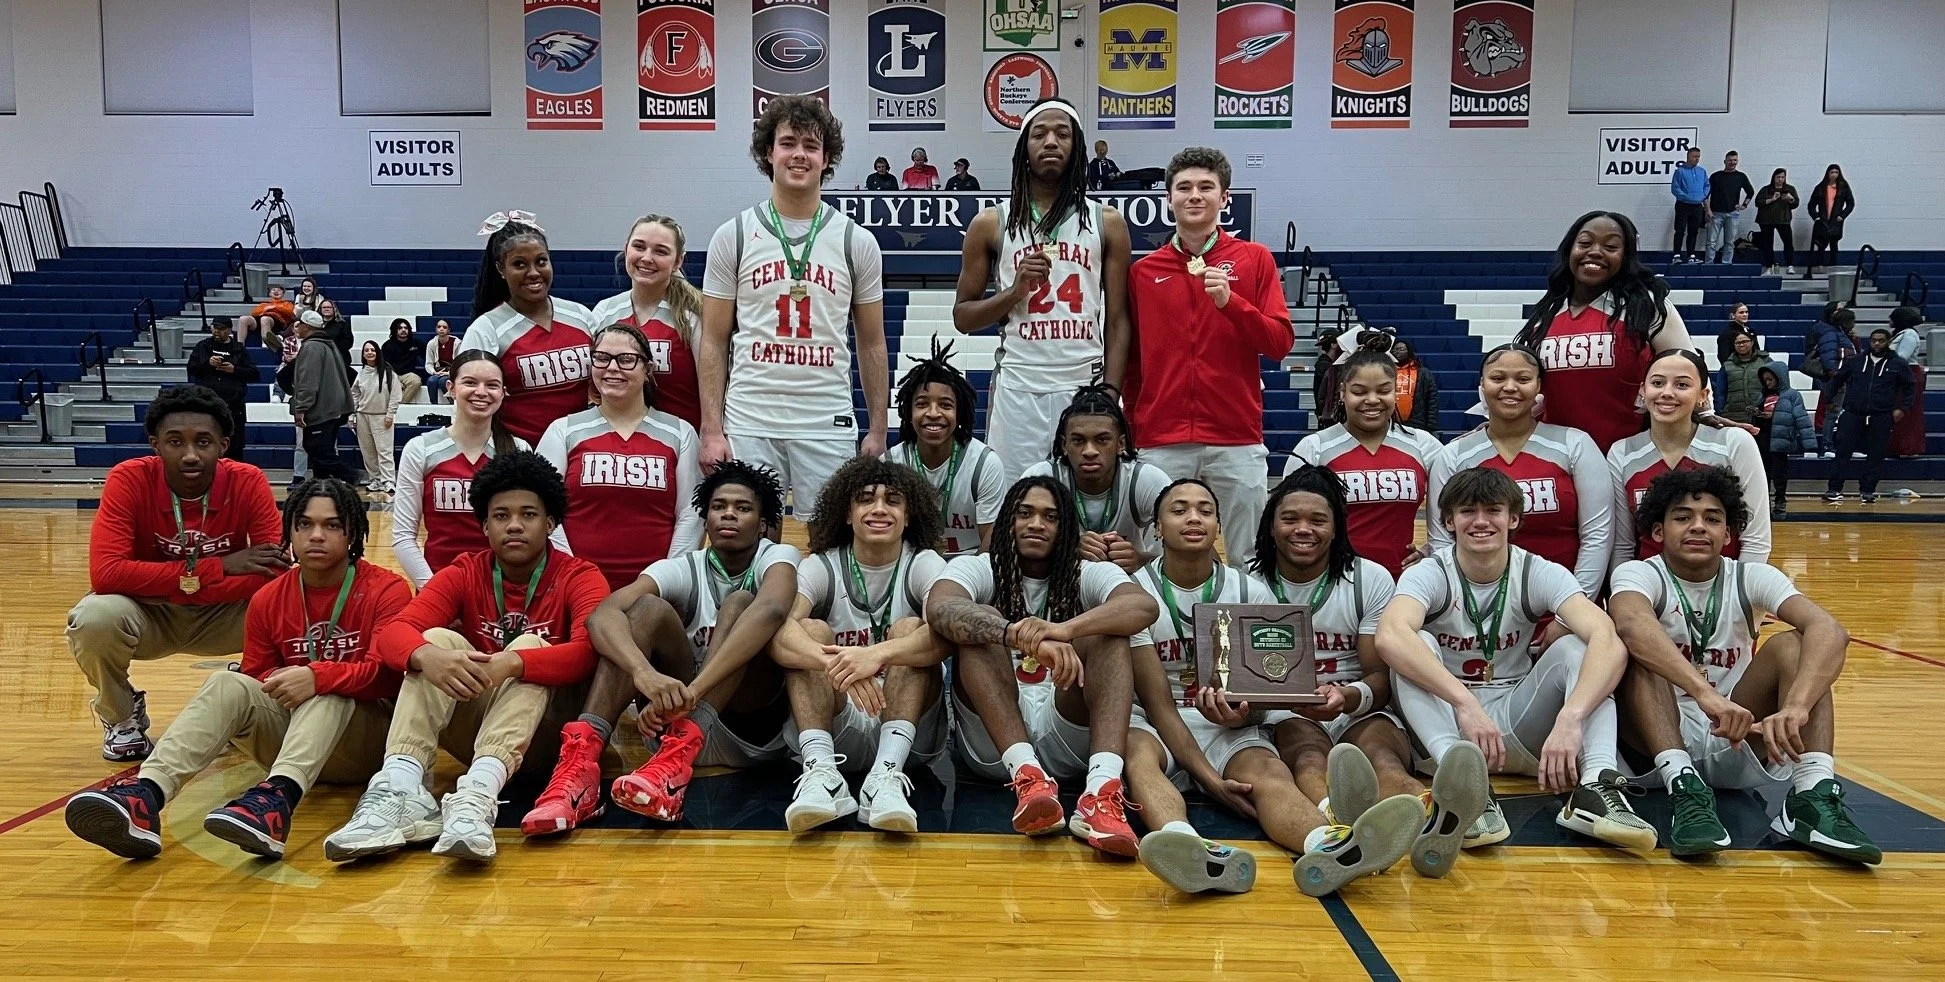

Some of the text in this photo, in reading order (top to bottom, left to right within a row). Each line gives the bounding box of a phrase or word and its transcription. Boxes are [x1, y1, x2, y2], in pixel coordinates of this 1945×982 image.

[990, 11, 1054, 32] OHSAA
[665, 30, 688, 66] F
[536, 98, 593, 116] EAGLES
[646, 97, 708, 116] REDMEN
[876, 97, 938, 118] FLYERS
[1101, 95, 1173, 115] PANTHERS
[1217, 95, 1290, 115] ROCKETS
[1336, 95, 1407, 114] KNIGHTS
[1451, 94, 1529, 113] BULLDOGS
[375, 140, 455, 154] VISITOR
[1606, 138, 1690, 152] VISITOR
[377, 162, 454, 176] ADULTS
[836, 197, 963, 227] FLYER
[1098, 197, 1234, 227] OUE
[1014, 241, 1092, 272] CERAL
[752, 260, 836, 296] CENRAL
[1028, 273, 1084, 314] 24
[775, 294, 812, 339] 11
[1019, 319, 1093, 340] CATHOLIC
[752, 342, 834, 367] CATHOLIC
[1540, 333, 1614, 370] RISH
[518, 345, 591, 388] IRISH
[582, 453, 667, 488] IRISH
[434, 479, 474, 511] IRI
[158, 538, 231, 555] RISH
[481, 621, 550, 639] IRH
[293, 636, 360, 652] IRISH
